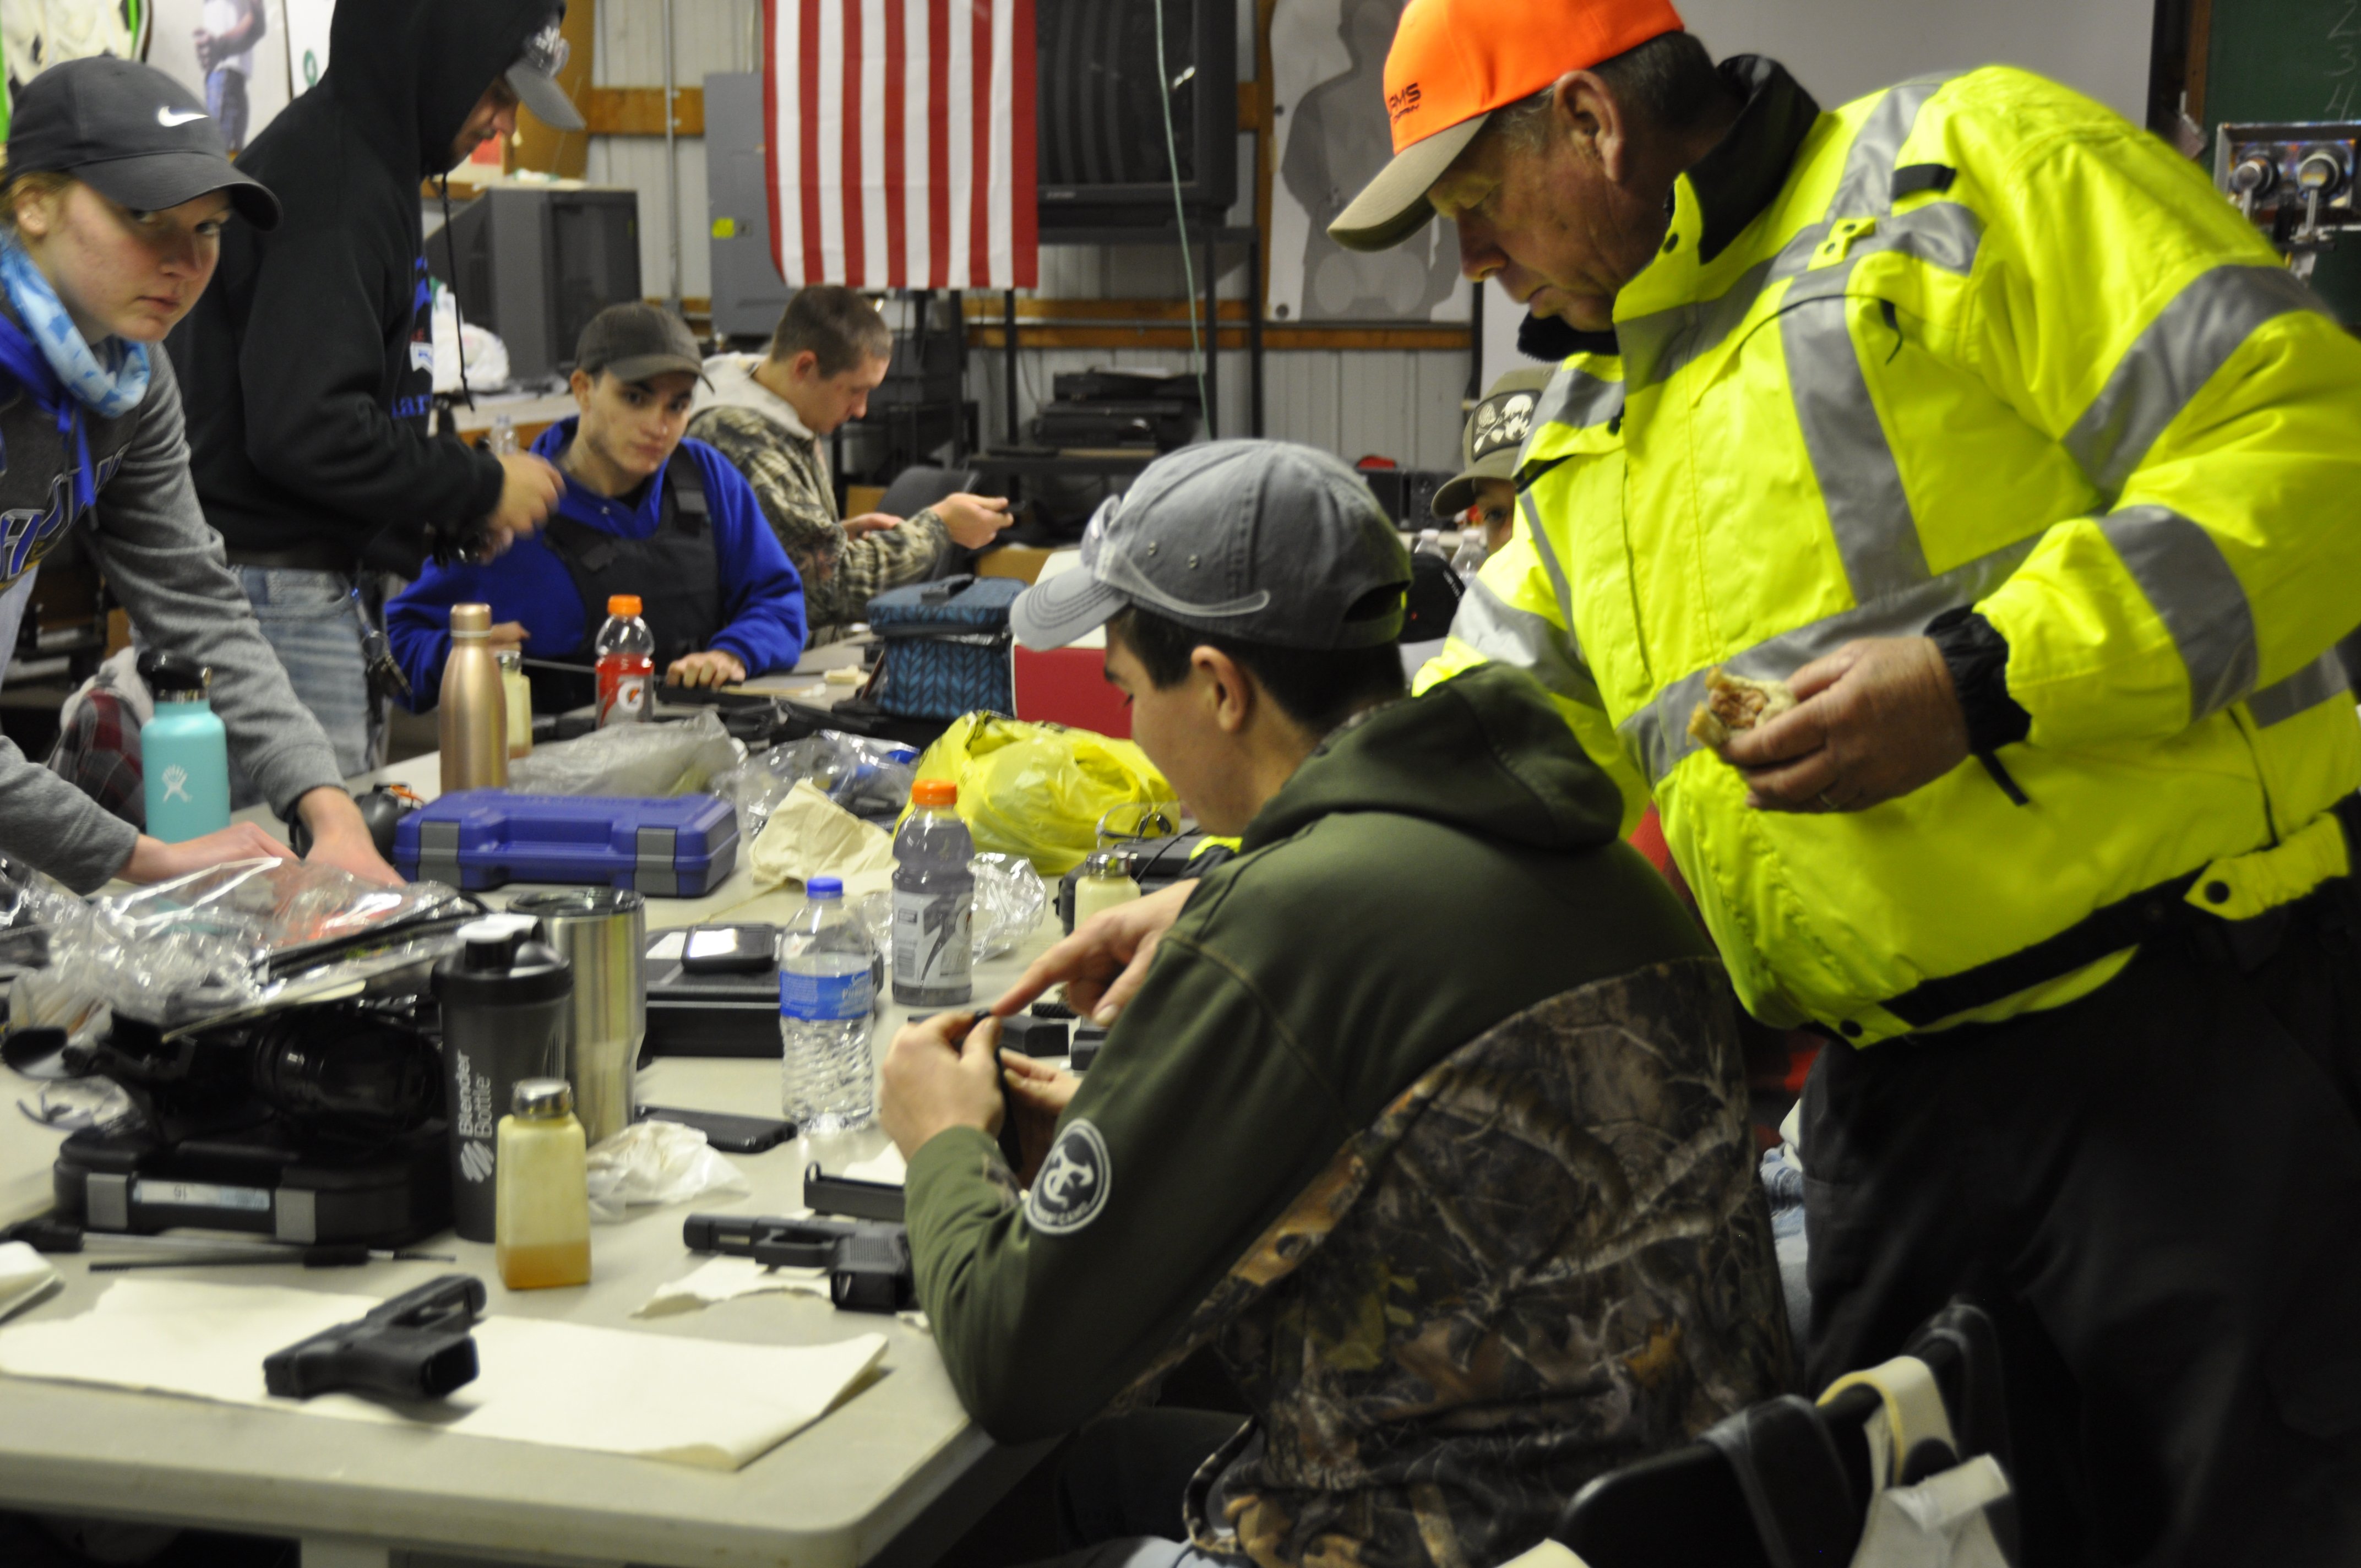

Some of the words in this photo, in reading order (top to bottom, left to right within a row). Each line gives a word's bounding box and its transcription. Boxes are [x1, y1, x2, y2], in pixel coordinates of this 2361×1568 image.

[617, 679, 645, 714] G
[456, 1048, 474, 1136] Blender
[473, 1075, 493, 1139] Bottle
